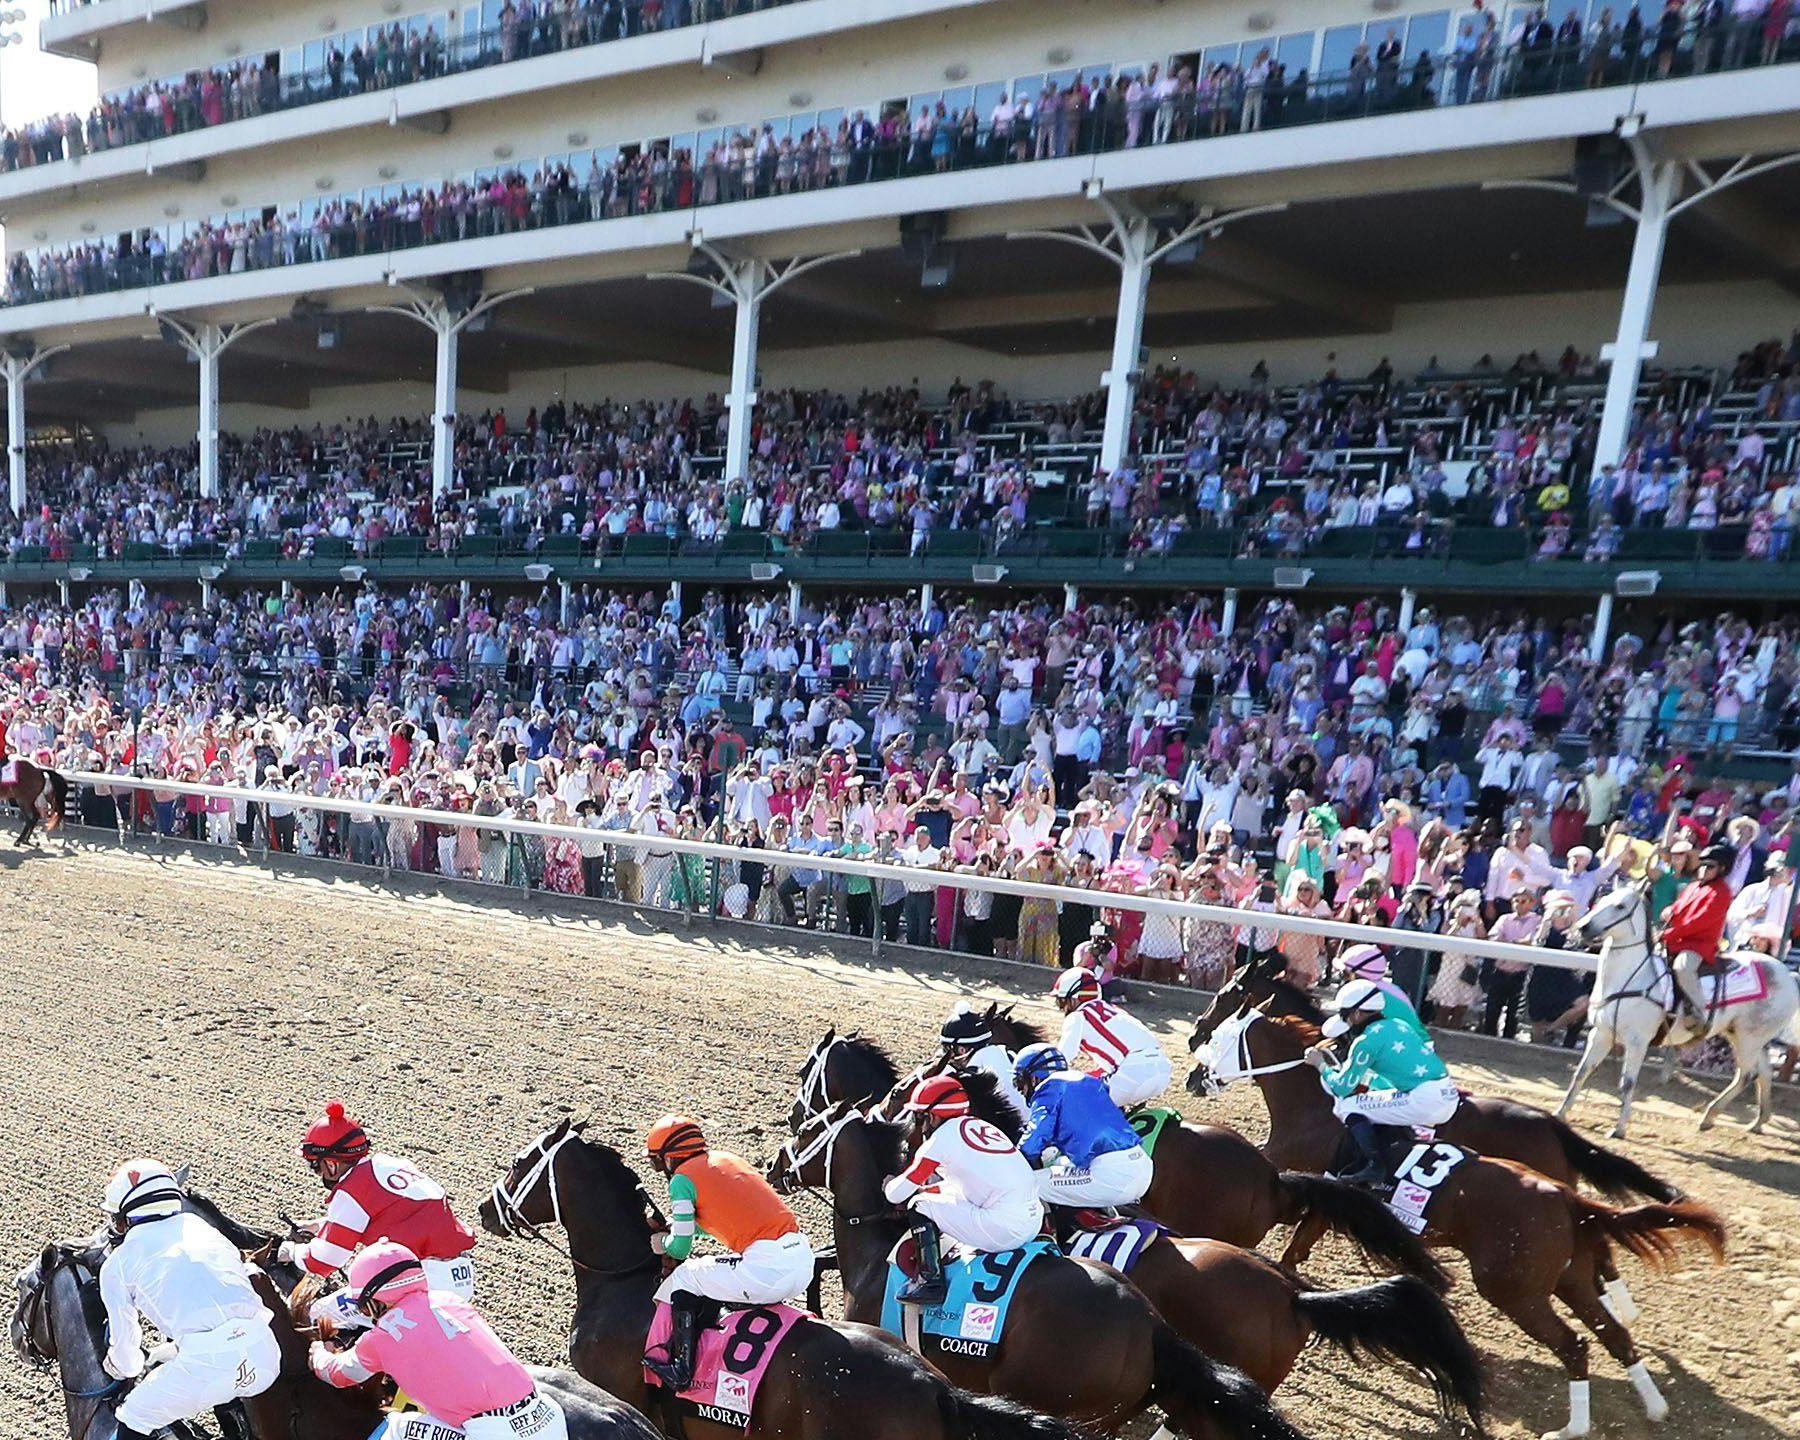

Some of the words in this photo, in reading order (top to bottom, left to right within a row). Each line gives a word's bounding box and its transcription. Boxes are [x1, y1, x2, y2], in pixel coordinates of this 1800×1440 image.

[1393, 1143, 1465, 1188] 13
[1066, 1225, 1142, 1273] 10
[451, 1264, 472, 1281] RDI
[972, 1250, 1028, 1303] 9
[722, 1307, 784, 1375] 8
[940, 1337, 989, 1357] COACH
[403, 1420, 431, 1439] JEFF
